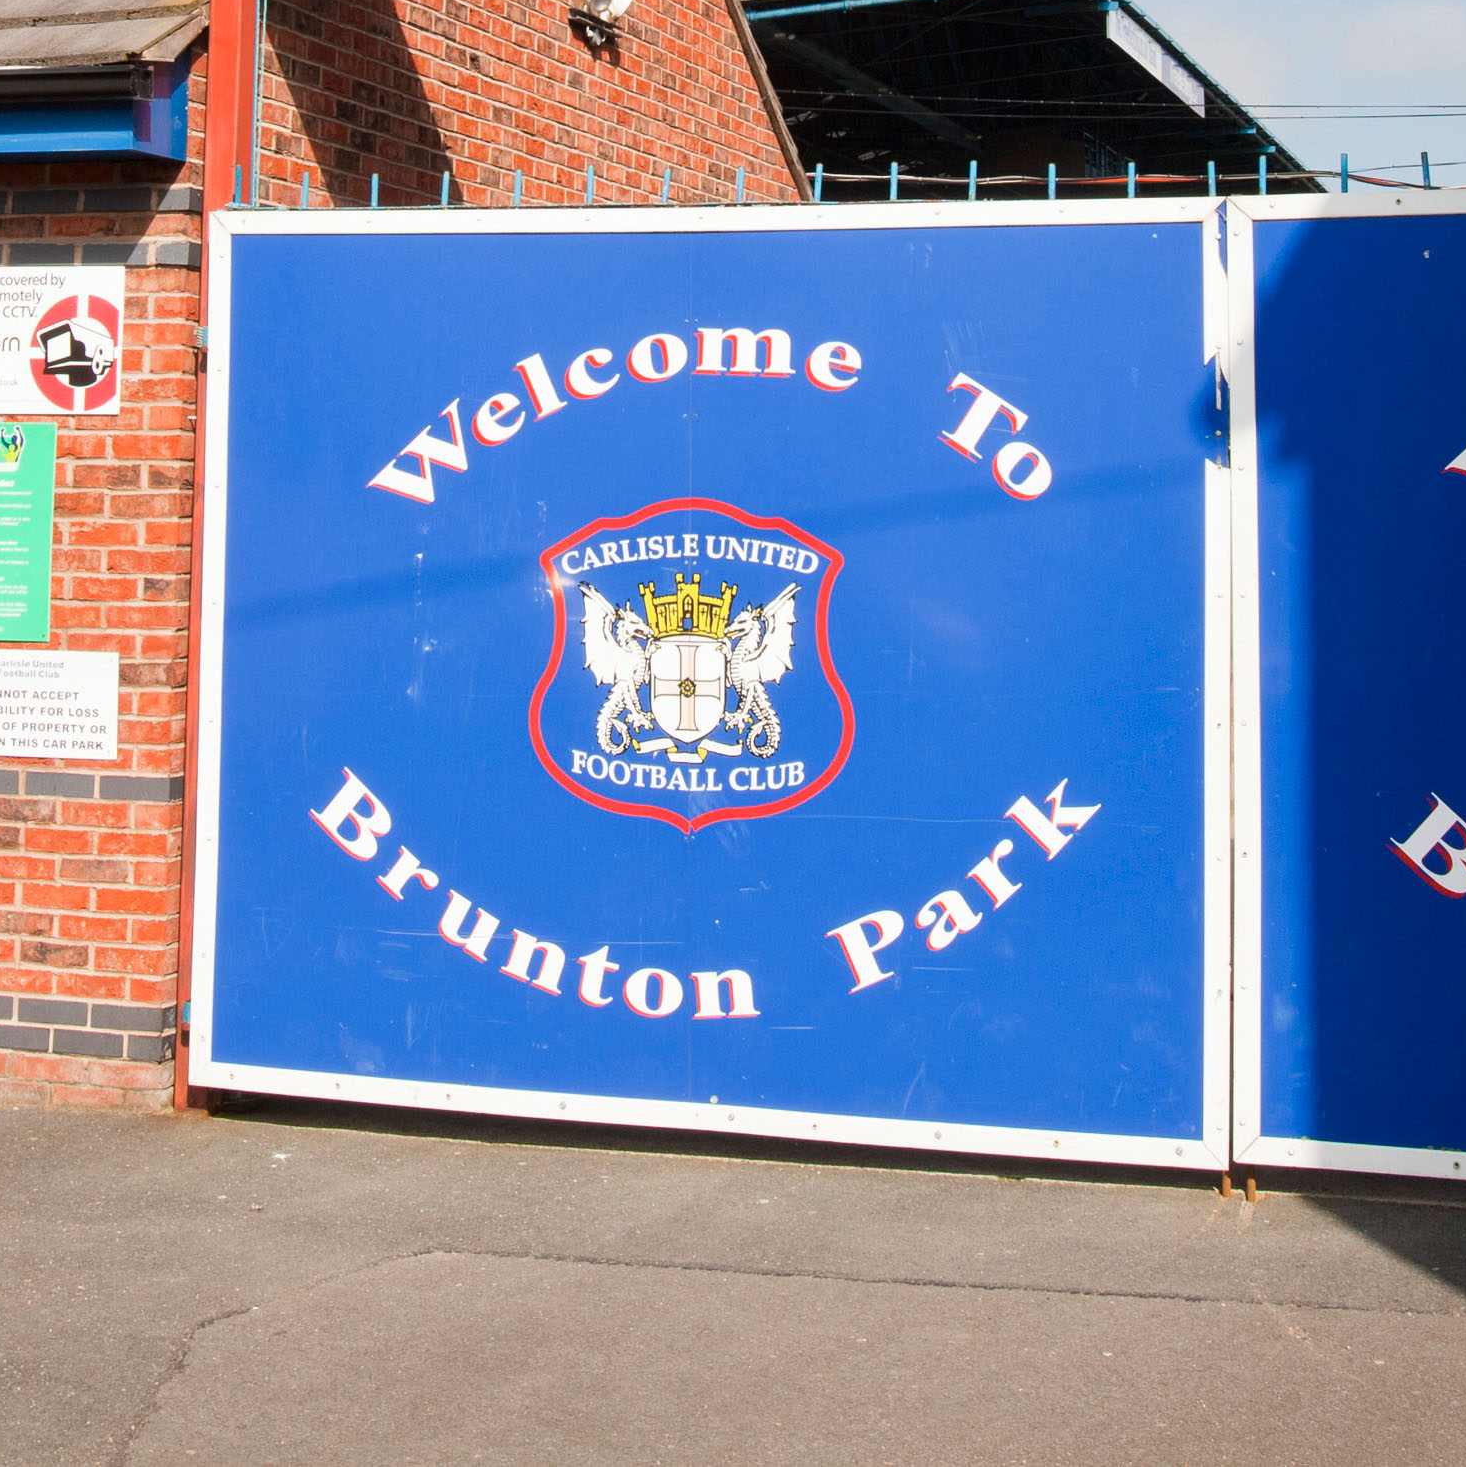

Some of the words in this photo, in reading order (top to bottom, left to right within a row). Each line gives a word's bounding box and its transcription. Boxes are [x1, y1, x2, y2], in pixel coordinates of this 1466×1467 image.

[0, 273, 48, 286] covered
[51, 273, 66, 289] by
[2, 306, 38, 318] CCTV.
[367, 324, 863, 505] Welcome
[937, 370, 1053, 502] To
[561, 534, 699, 575] CARLISLE
[705, 535, 819, 574] UNITED
[32, 660, 65, 669] United
[38, 670, 60, 679] Club
[32, 691, 80, 701] ACCEPT
[40, 707, 64, 717] FOR
[68, 708, 100, 718] LOSS
[2, 722, 17, 731] OF
[22, 722, 85, 733] PROPERTY
[90, 725, 107, 734] OR
[10, 738, 38, 748] THIS
[43, 739, 67, 749] CAR
[71, 740, 103, 750] PARK
[571, 749, 722, 791] FOOTBALL
[728, 761, 805, 791] CLUB
[309, 766, 762, 1021] Brunton
[825, 777, 1103, 994] Park
